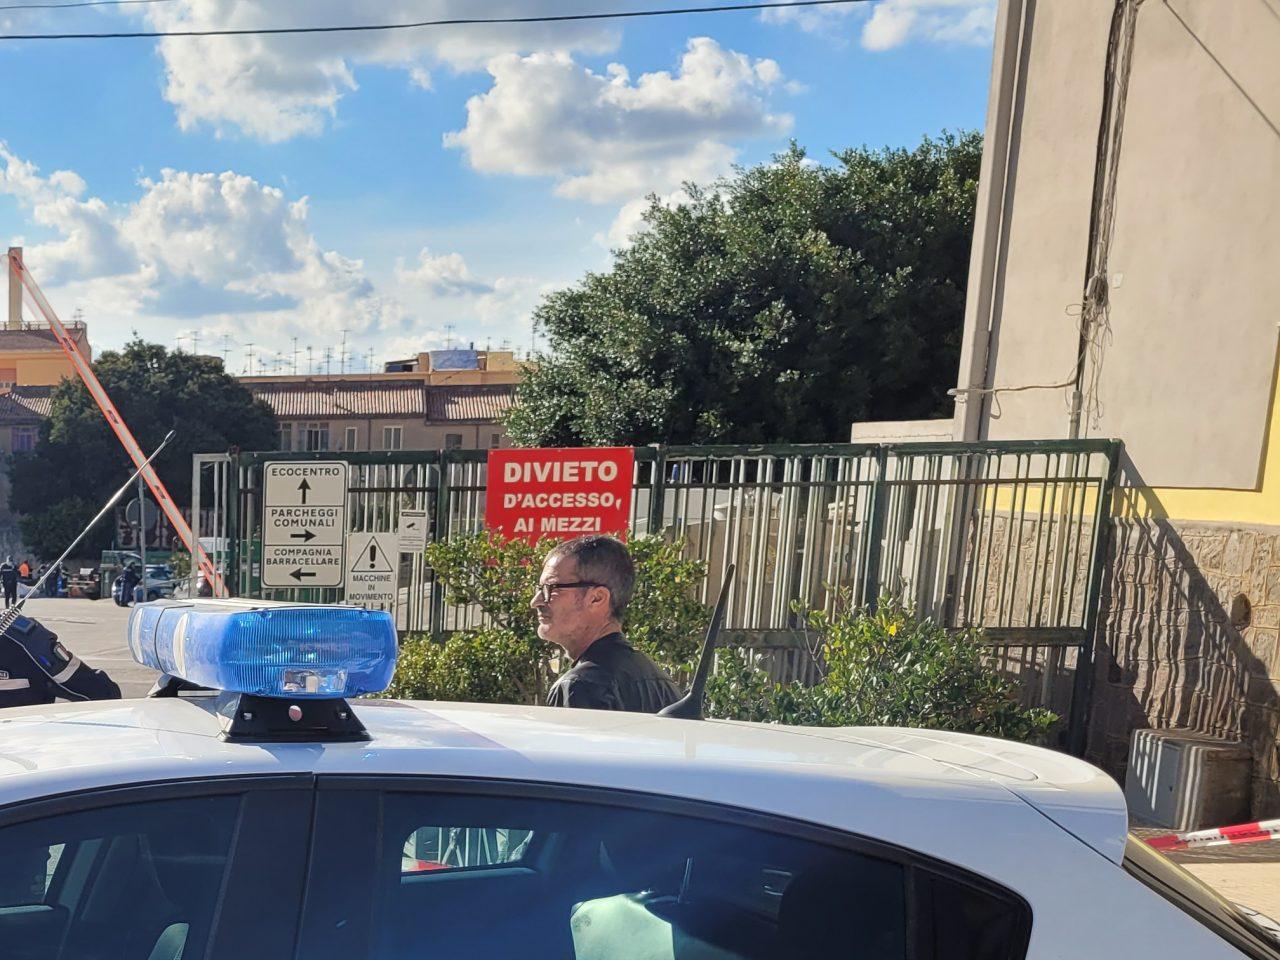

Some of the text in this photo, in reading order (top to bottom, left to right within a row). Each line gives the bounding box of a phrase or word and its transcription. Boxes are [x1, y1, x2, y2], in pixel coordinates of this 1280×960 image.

[271, 467, 341, 477] ECOCENTRO
[503, 460, 619, 483] DIVIETO
[271, 508, 338, 518] PARCHEGGI
[273, 518, 335, 528] COMUNALI
[513, 516, 601, 532] AI MEZZI
[273, 548, 332, 556] COMPAGNIA
[266, 557, 340, 566] BARRACELLARE
[352, 574, 392, 582] MACCHINE
[349, 592, 394, 601] MOVIMENTO
